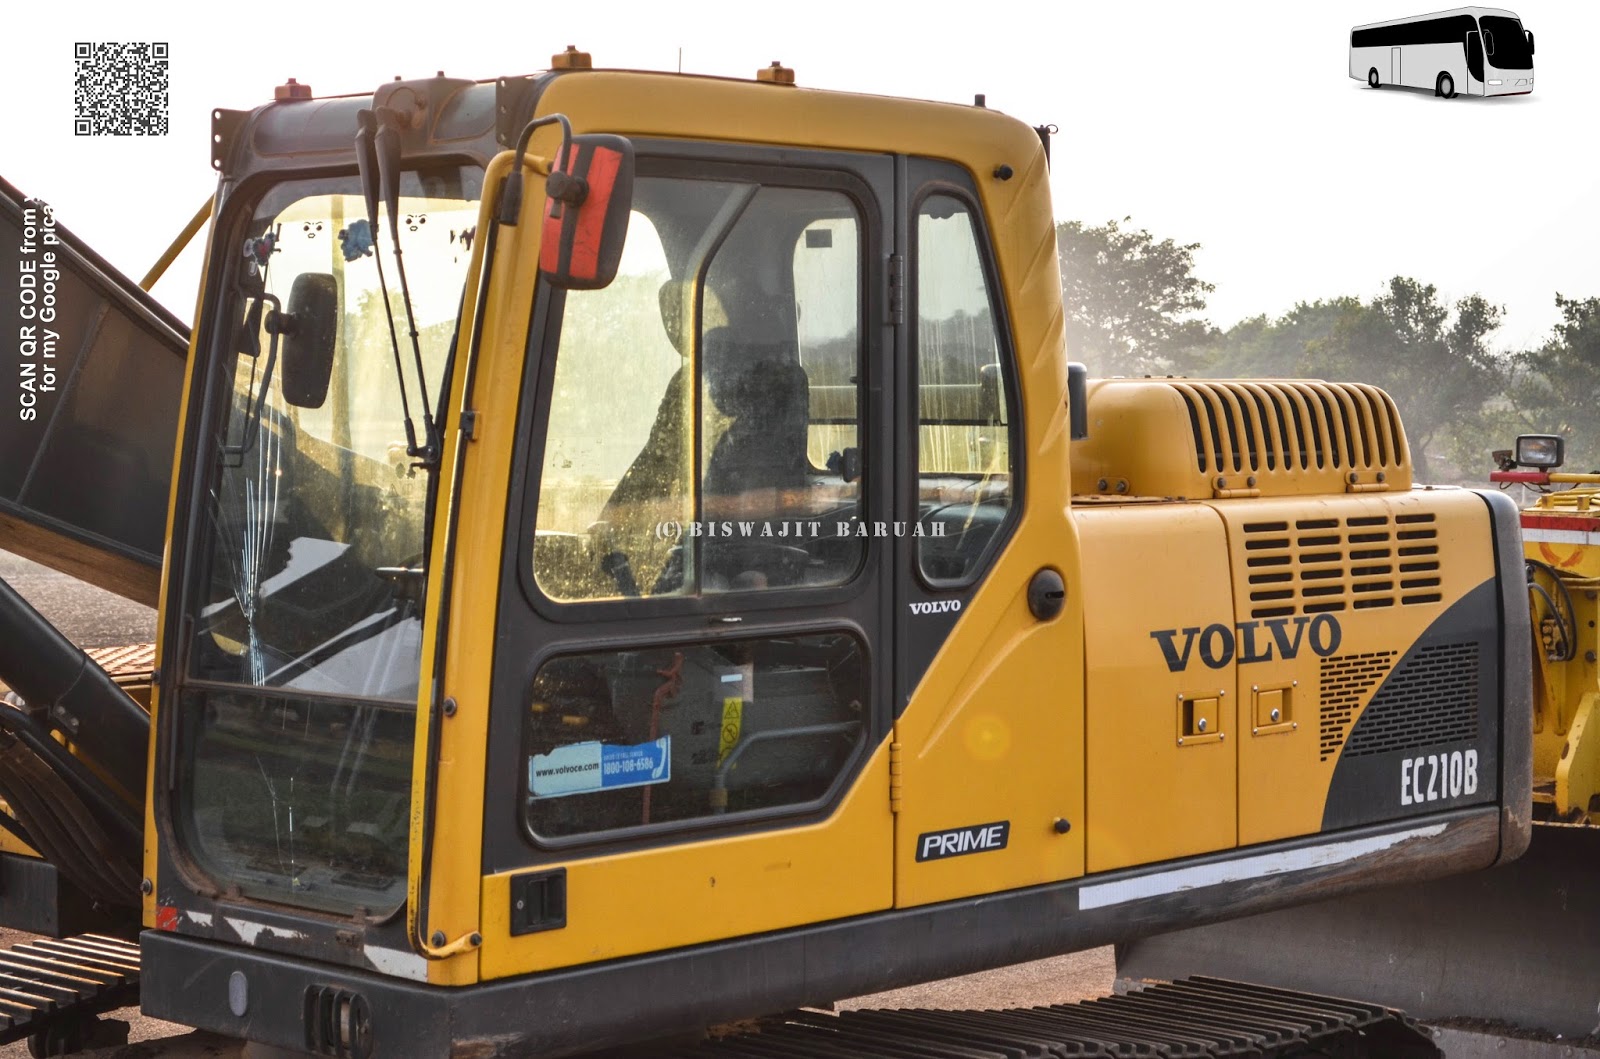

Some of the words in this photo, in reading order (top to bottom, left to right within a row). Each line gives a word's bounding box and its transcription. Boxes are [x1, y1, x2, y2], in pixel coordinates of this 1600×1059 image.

[909, 599, 961, 615] VOLVO
[1150, 613, 1342, 673] VOLVO
[536, 762, 599, 777] www.volvoce.com
[603, 758, 653, 775] 1800-108-6586
[1400, 748, 1479, 806] EC210B
[922, 825, 1004, 858] PRIME
